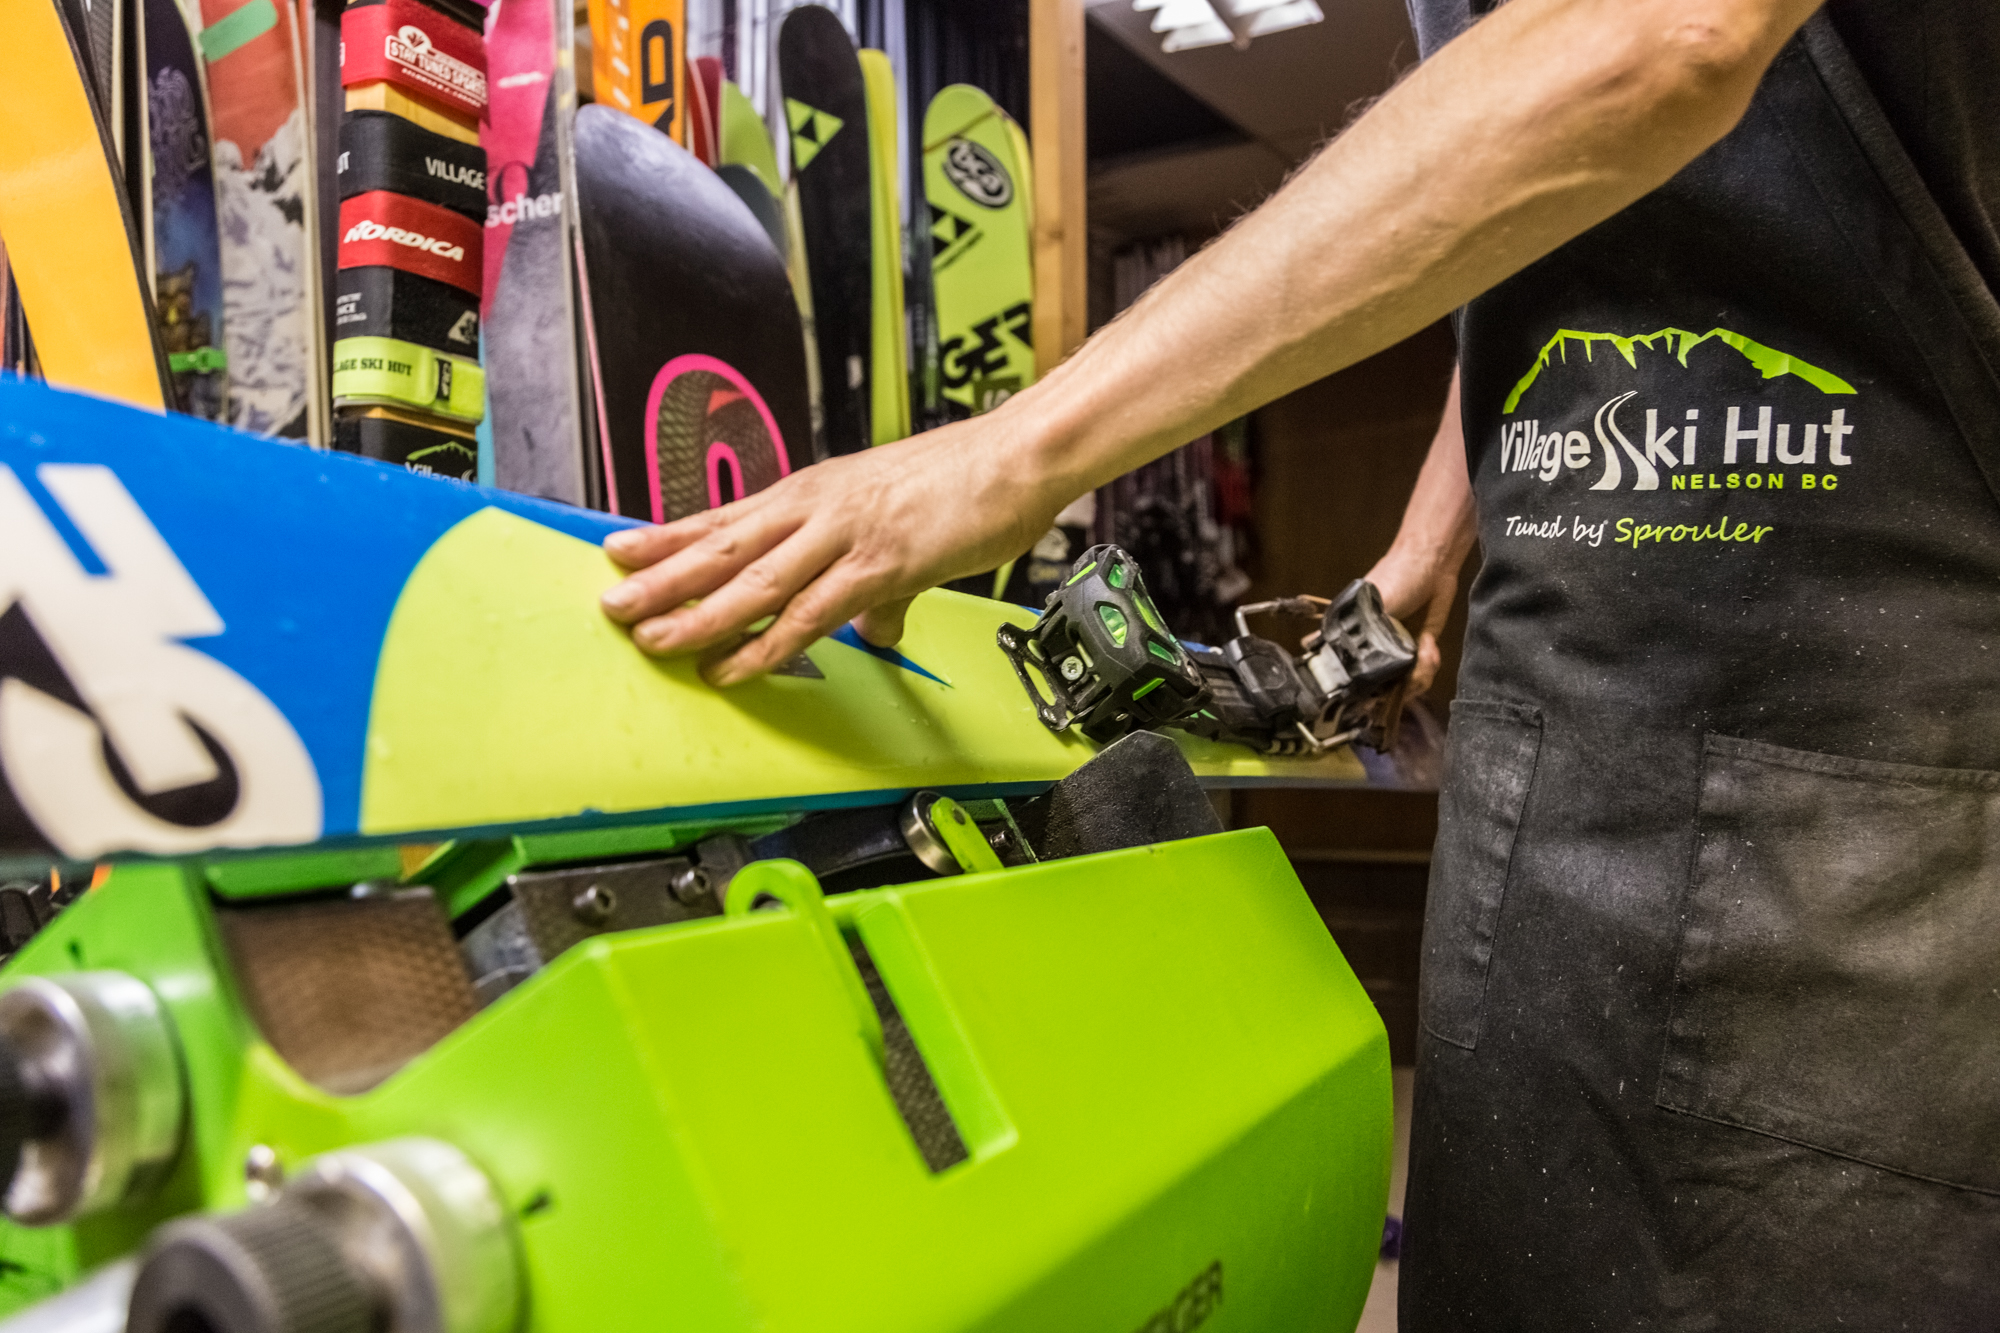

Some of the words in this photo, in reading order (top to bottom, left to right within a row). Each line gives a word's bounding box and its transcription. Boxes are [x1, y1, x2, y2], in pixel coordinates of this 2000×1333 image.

[425, 156, 486, 191] VILLAGE
[484, 192, 565, 228] scher
[343, 220, 464, 262] NORDICA
[361, 358, 383, 370] SKI
[387, 360, 412, 376] HUT
[1500, 419, 1591, 481] Village
[1723, 406, 1854, 466] Hut
[1671, 473, 1784, 490] NELSON
[1801, 473, 1838, 490] BC
[1506, 516, 1567, 538] Tuned
[1572, 515, 1606, 547] by
[1614, 515, 1774, 549] Sprouler
